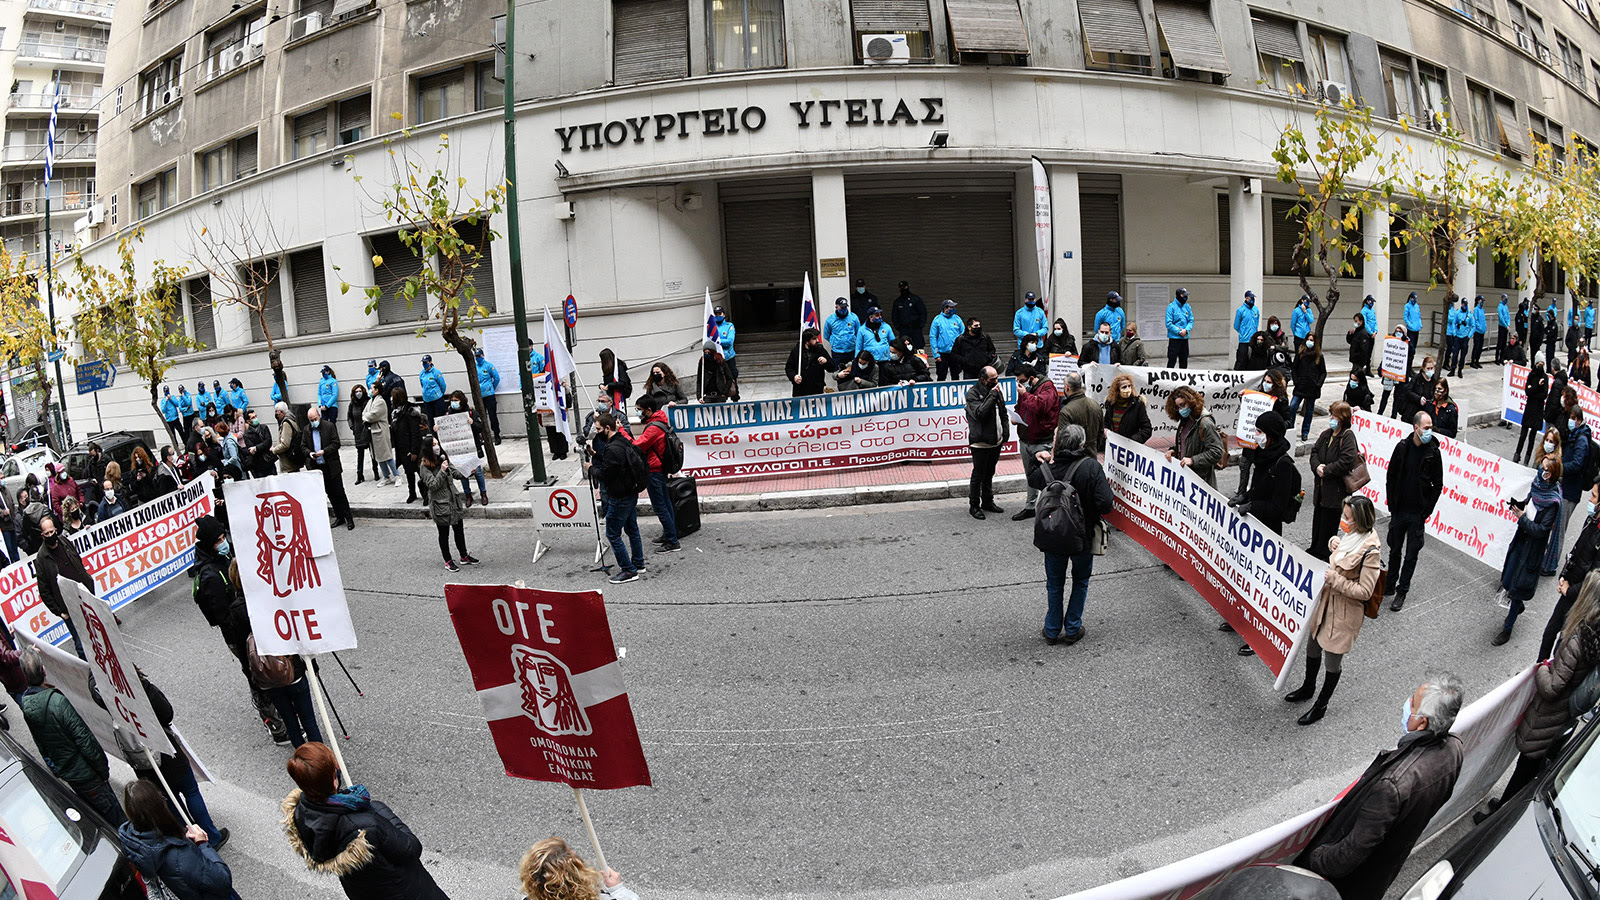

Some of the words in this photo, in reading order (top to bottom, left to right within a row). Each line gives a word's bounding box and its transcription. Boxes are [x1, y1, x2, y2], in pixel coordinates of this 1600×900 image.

[555, 105, 767, 152] ΥΠΟΥΡΓΕΙΟ
[790, 97, 944, 128] ΥΓΕΙΑΣ
[673, 409, 690, 430] ΟΙ
[694, 404, 757, 429] ΑΝΑΓΚΕΣ
[760, 400, 794, 423] ΜΑΣ
[798, 397, 827, 419] ΔΕΝ
[831, 388, 908, 418] ΜΠΑΙΝΟΥΝ
[912, 387, 928, 408] ΣΕ
[694, 431, 739, 446] Εδώ
[748, 430, 780, 443] και
[787, 424, 843, 439] τώρα
[851, 417, 910, 436] μέτρα
[707, 450, 736, 461] και
[744, 439, 852, 458] ασφάλειας
[860, 435, 895, 448] στα
[902, 426, 969, 443] σχολεί
[1376, 419, 1403, 439] τώρα
[734, 460, 804, 474] ΣΥΛΛΟΓΟΙ
[808, 458, 835, 468] Π.Ε.
[849, 448, 927, 465] Πρωτοβουλία
[1440, 437, 1462, 458] ολεία
[0, 566, 27, 595] ΟΧΙ
[27, 560, 37, 579] Σ
[91, 515, 133, 548] ΧΑΜΕΝΗ
[133, 497, 175, 527] ΣΧΟΛΙΚΗ
[175, 480, 205, 509] ΧΡΟΝΙΑ
[1109, 443, 1156, 481] ΤΕΡΜΑ
[1160, 465, 1186, 498] ΠΙΑ
[1189, 482, 1226, 528] ΣΤΗΝ
[1227, 512, 1315, 601] ΚΟΡΟΪΔΙΑ
[1107, 462, 1133, 486] ΚΡΑΤΙΚΗ
[1133, 477, 1164, 504] ΕΥΘΥΝΗ
[1164, 493, 1171, 506] Η
[1171, 498, 1198, 523] ΥΓΙΕΙΝΗ
[1198, 517, 1211, 535] ΚΑΙ
[1210, 529, 1216, 541] Η
[1215, 533, 1253, 575] ΑΣΦΑΛΕΙΑ
[1254, 564, 1271, 590] ΣΤΑ
[1272, 579, 1307, 618] ΣΧΟΛΕΙ
[1149, 502, 1173, 527] ΥΓΕΙΑ
[1179, 521, 1214, 561] ΣΤΑΘΕΡΗ
[1214, 554, 1251, 597] ΔΟΥΛΕΙΑ
[1253, 587, 1269, 614] ΓΙΑ
[10, 585, 42, 616] ΜΟΡ
[30, 610, 50, 633] σε
[95, 566, 123, 592] ΤΑ
[1130, 514, 1177, 551] ΕΚΠΑΙΔΕΥΤΙΚΩΝ
[1252, 616, 1290, 658] ΠΑΠΑΜΑΥ
[274, 608, 323, 641] ΟΓΕ
[492, 598, 561, 644] ΟΓΕ
[530, 736, 598, 758] ΟΜΟΣΠΟΝΔΙΑ
[542, 751, 592, 769] ΓΥΝΑΙΚΩΝ
[548, 763, 596, 782] ΕΛΛΑΔΑΣ
